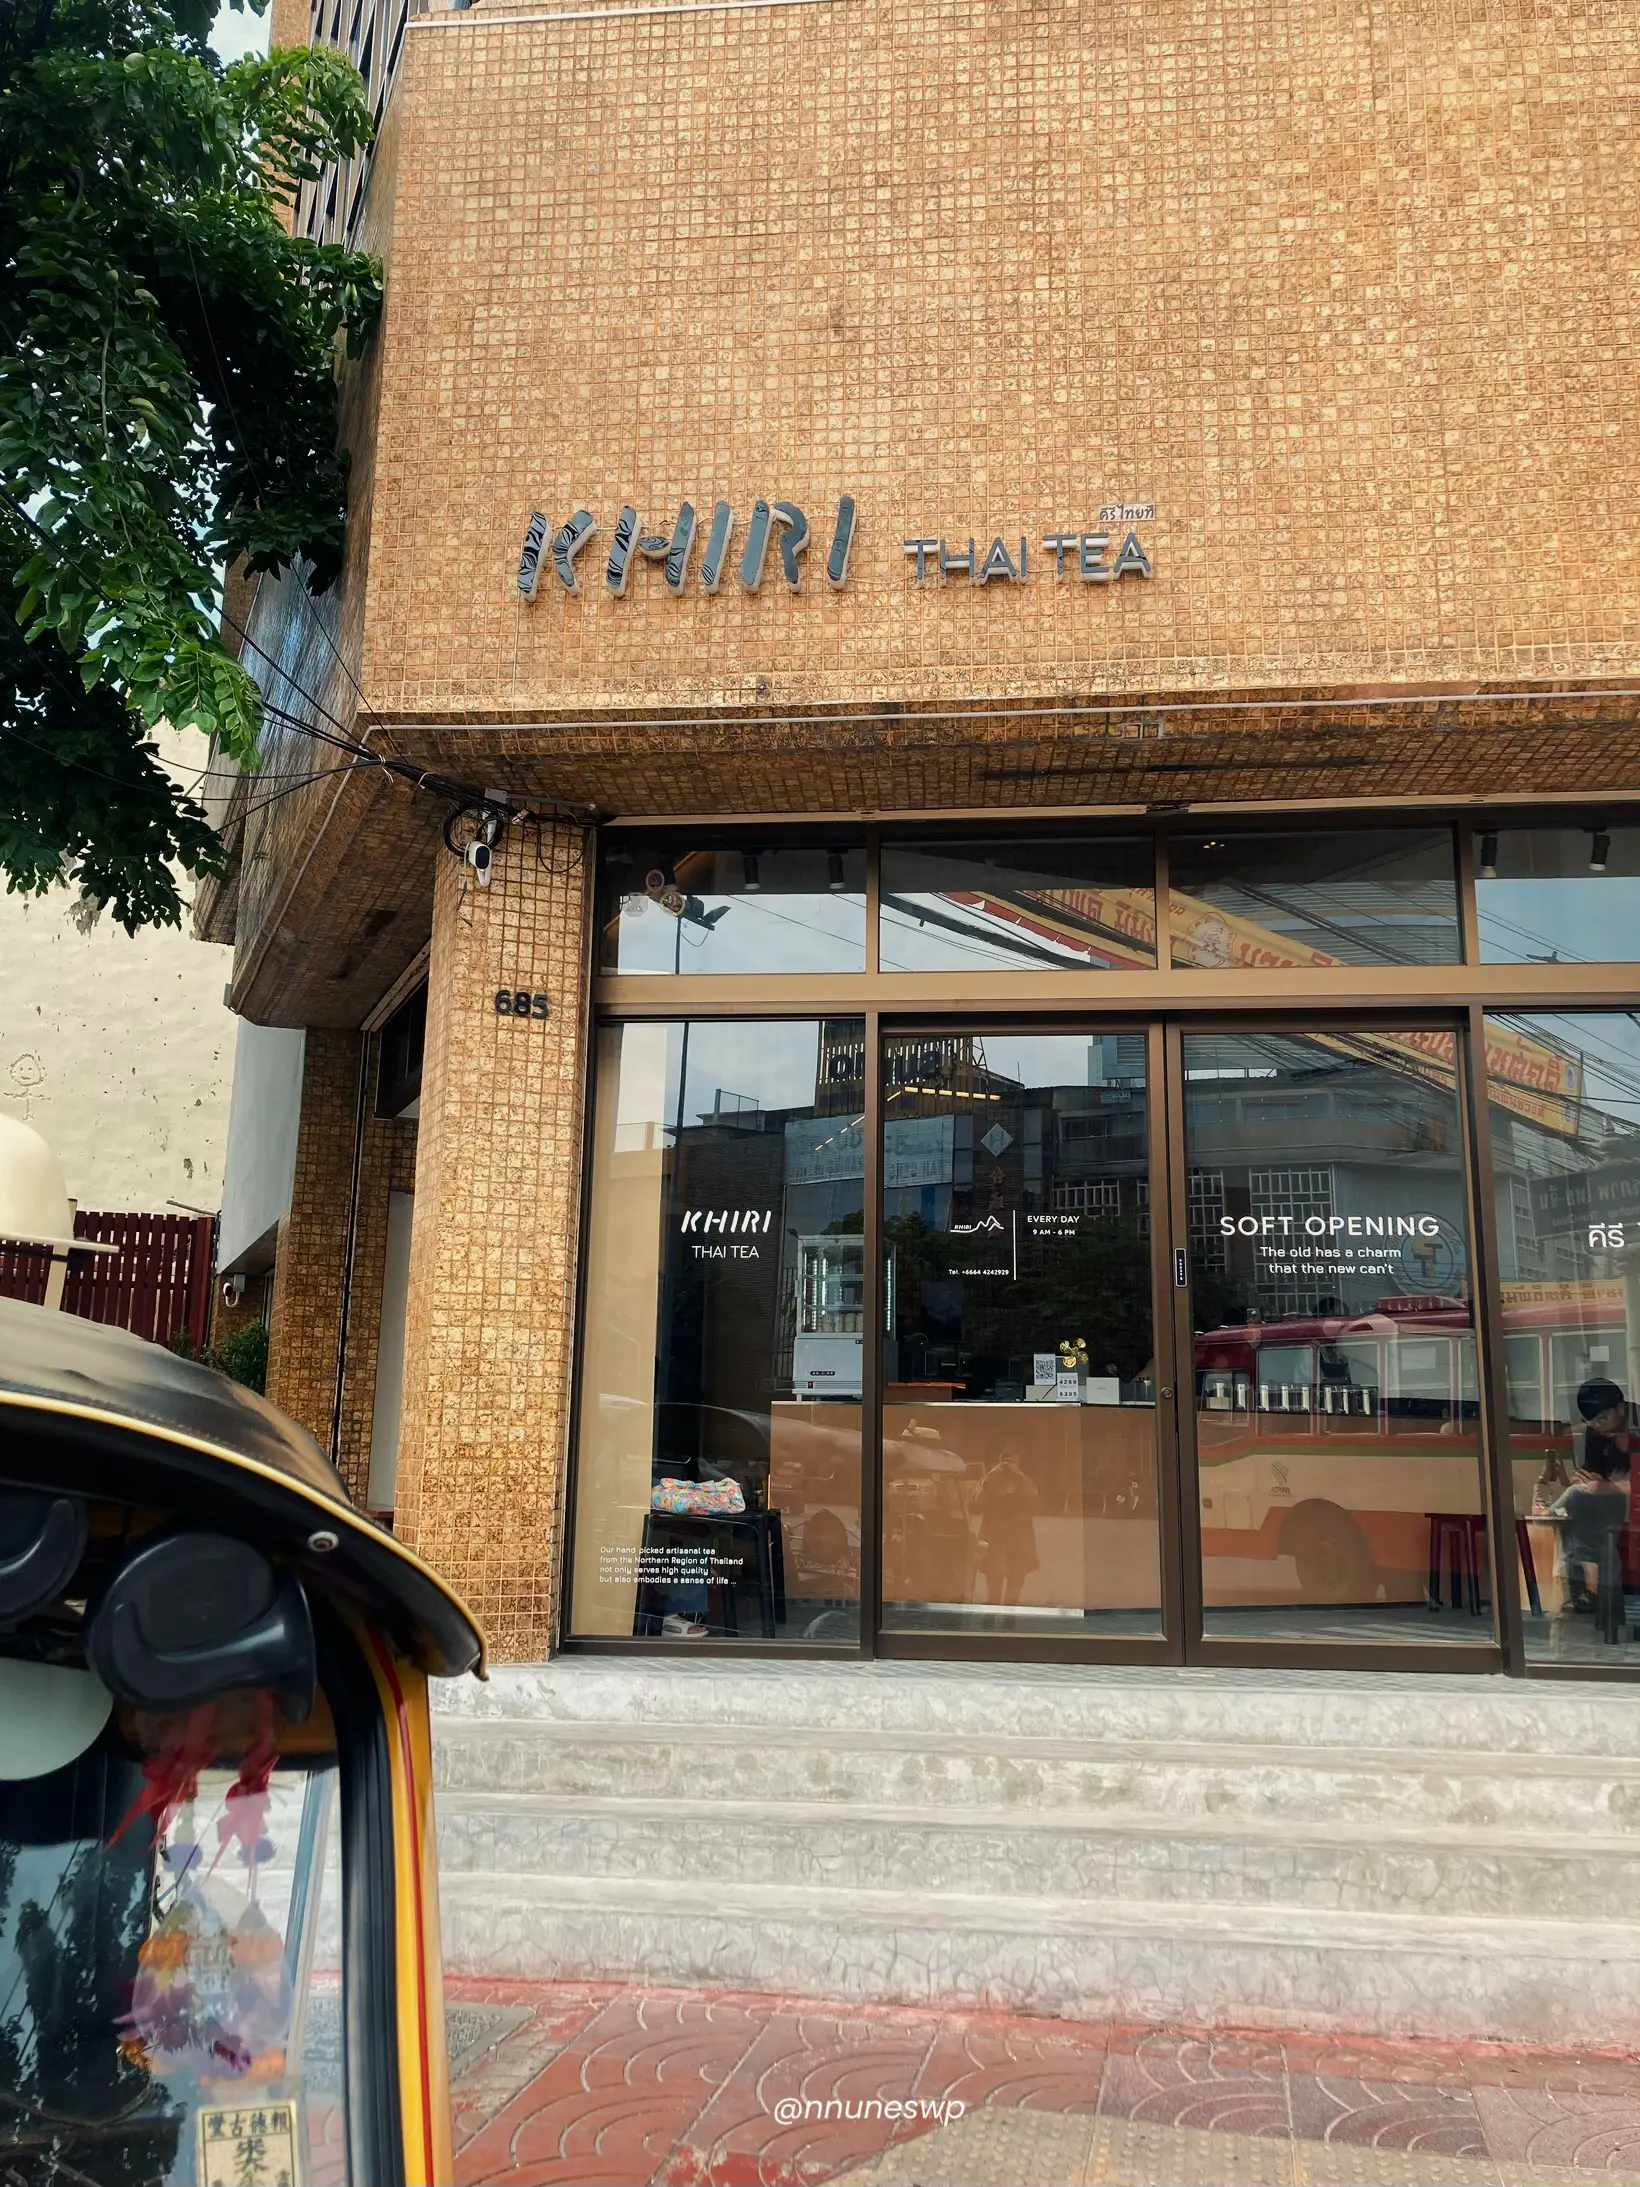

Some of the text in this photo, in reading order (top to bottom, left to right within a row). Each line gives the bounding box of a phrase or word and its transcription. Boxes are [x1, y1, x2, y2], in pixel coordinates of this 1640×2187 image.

[516, 495, 857, 600] KHIRI
[904, 531, 1152, 588] THAI TEA
[495, 989, 549, 1019] 685
[681, 1210, 772, 1233] KHIRI
[1027, 1215, 1080, 1224] EVERY DAY
[1220, 1216, 1440, 1237] SOFT OPENING
[1588, 1222, 1625, 1249] คีรี
[692, 1245, 760, 1259] THAI TEA
[1260, 1246, 1401, 1258] The old has a charm
[1269, 1263, 1394, 1274] that the new can't
[600, 1546, 716, 1555] Our hand picked artisanal tea
[600, 1556, 617, 1564] from
[620, 1556, 632, 1564] the
[635, 1556, 669, 1564] Northern
[671, 1556, 698, 1566] Region
[710, 1557, 744, 1565] Thailand
[615, 1566, 632, 1575] only
[661, 1566, 679, 1575] high
[681, 1567, 709, 1576] quality
